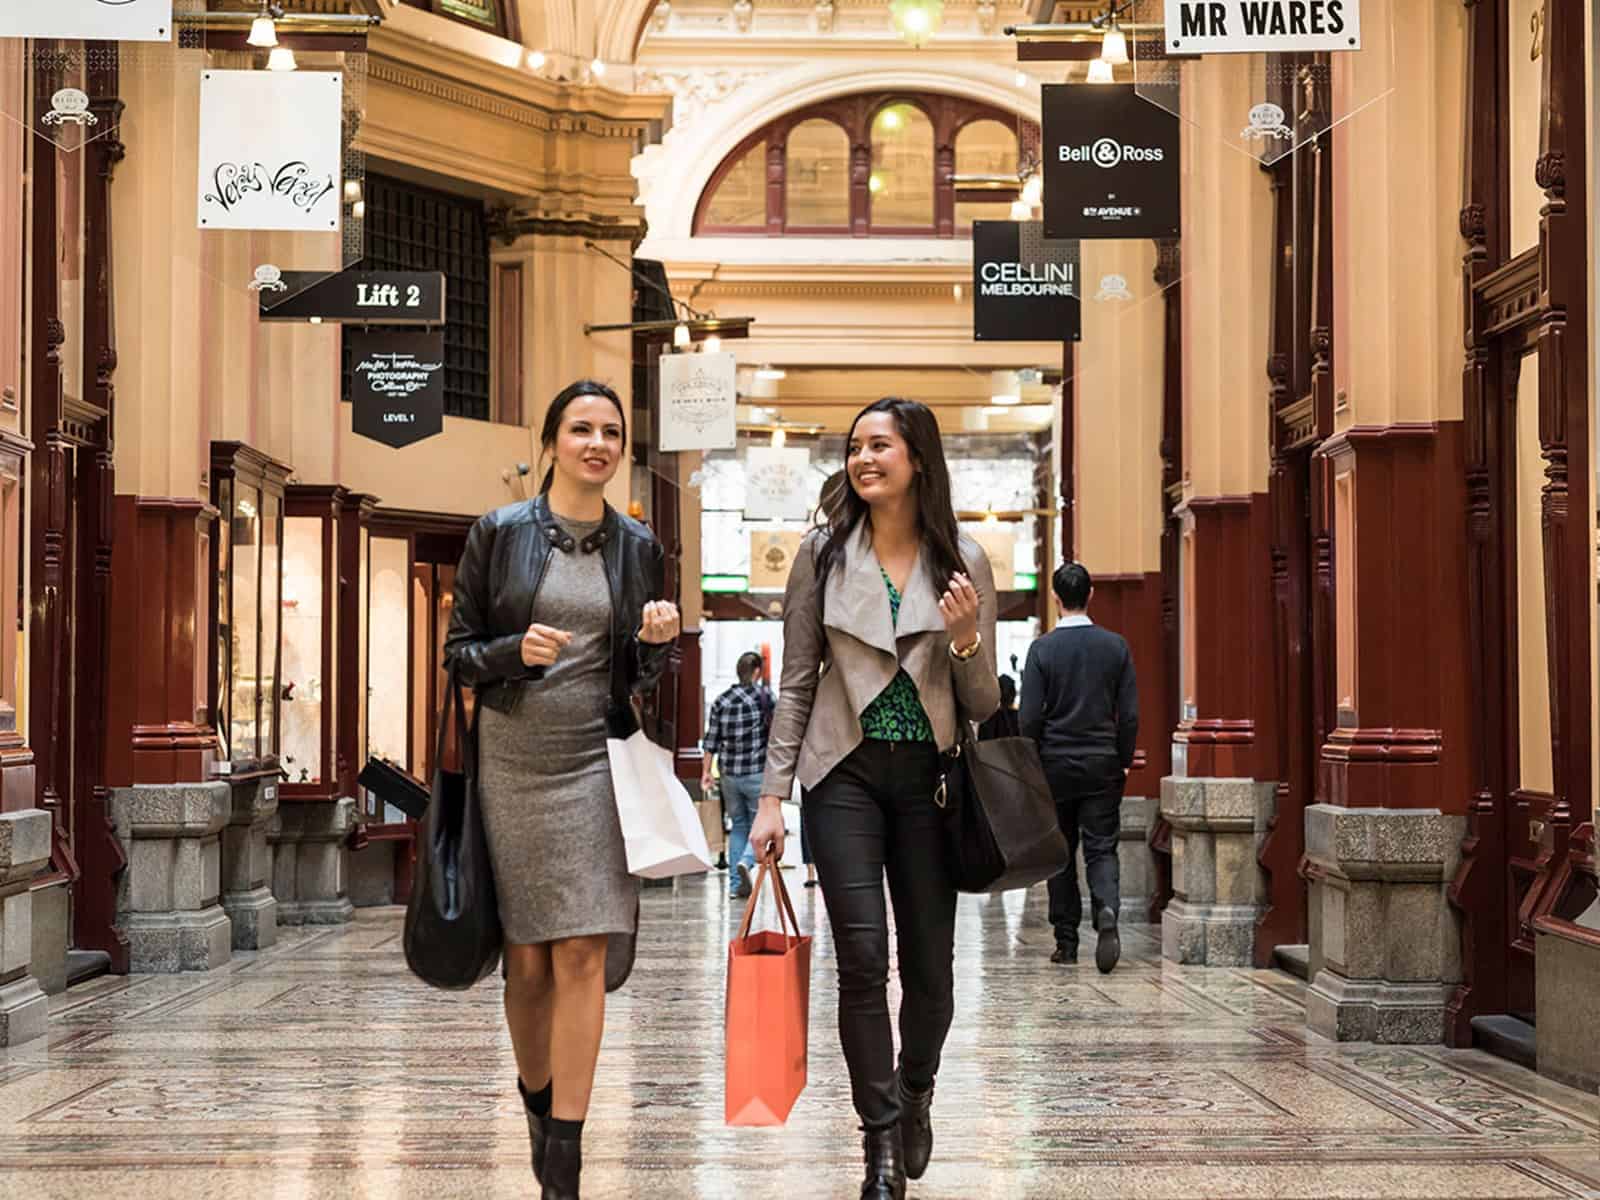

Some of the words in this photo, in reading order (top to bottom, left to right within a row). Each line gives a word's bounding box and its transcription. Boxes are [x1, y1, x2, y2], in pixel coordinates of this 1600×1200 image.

[1180, 3, 1228, 37] MR
[1240, 0, 1344, 36] WARES
[1059, 145, 1091, 161] Bell
[1122, 145, 1164, 161] Ross
[1097, 207, 1133, 216] AVENUE
[981, 262, 1073, 282] CELLINI
[357, 284, 400, 307] Lift
[406, 285, 421, 307] 2
[981, 283, 1073, 296] MELBOURNE
[367, 371, 429, 381] PHOTOGRAPHY
[383, 413, 409, 422] LEVEL
[410, 413, 415, 422] 1
